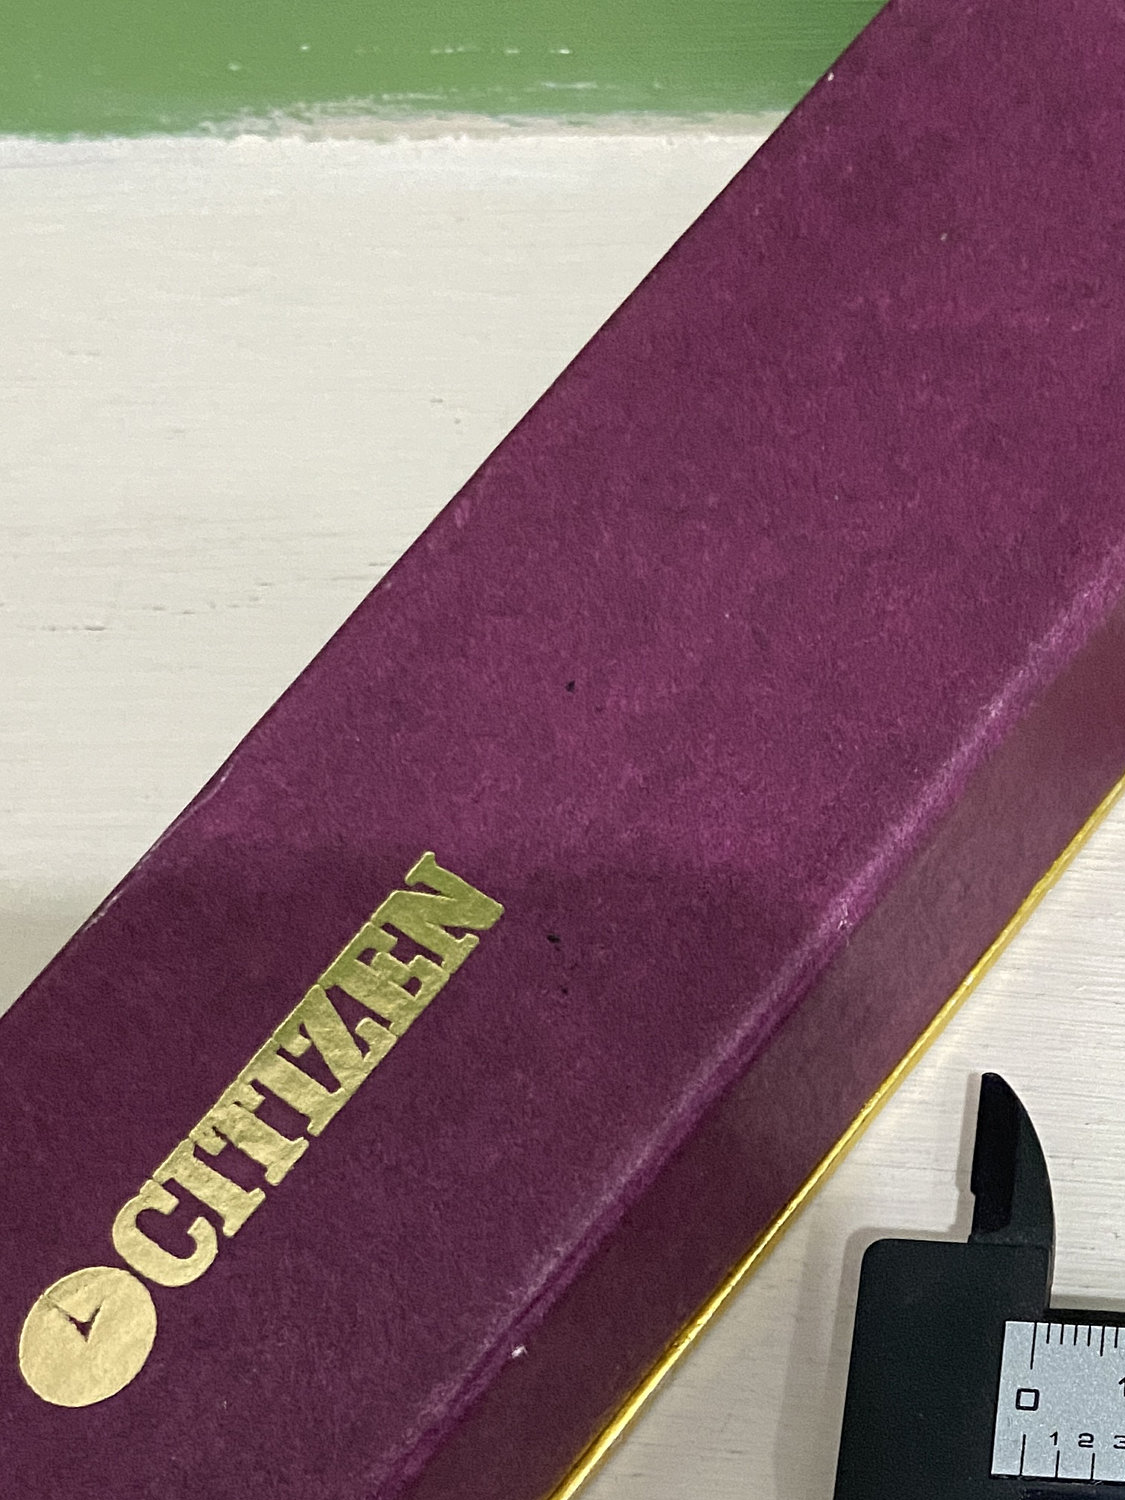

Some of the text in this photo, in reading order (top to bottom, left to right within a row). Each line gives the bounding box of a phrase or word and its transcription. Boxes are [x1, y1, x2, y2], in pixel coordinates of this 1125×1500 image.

[111, 851, 504, 1288] CITIZEN
[1015, 1388, 1040, 1412] 0
[1049, 1431, 1059, 1446] 1
[1077, 1432, 1095, 1449] 2
